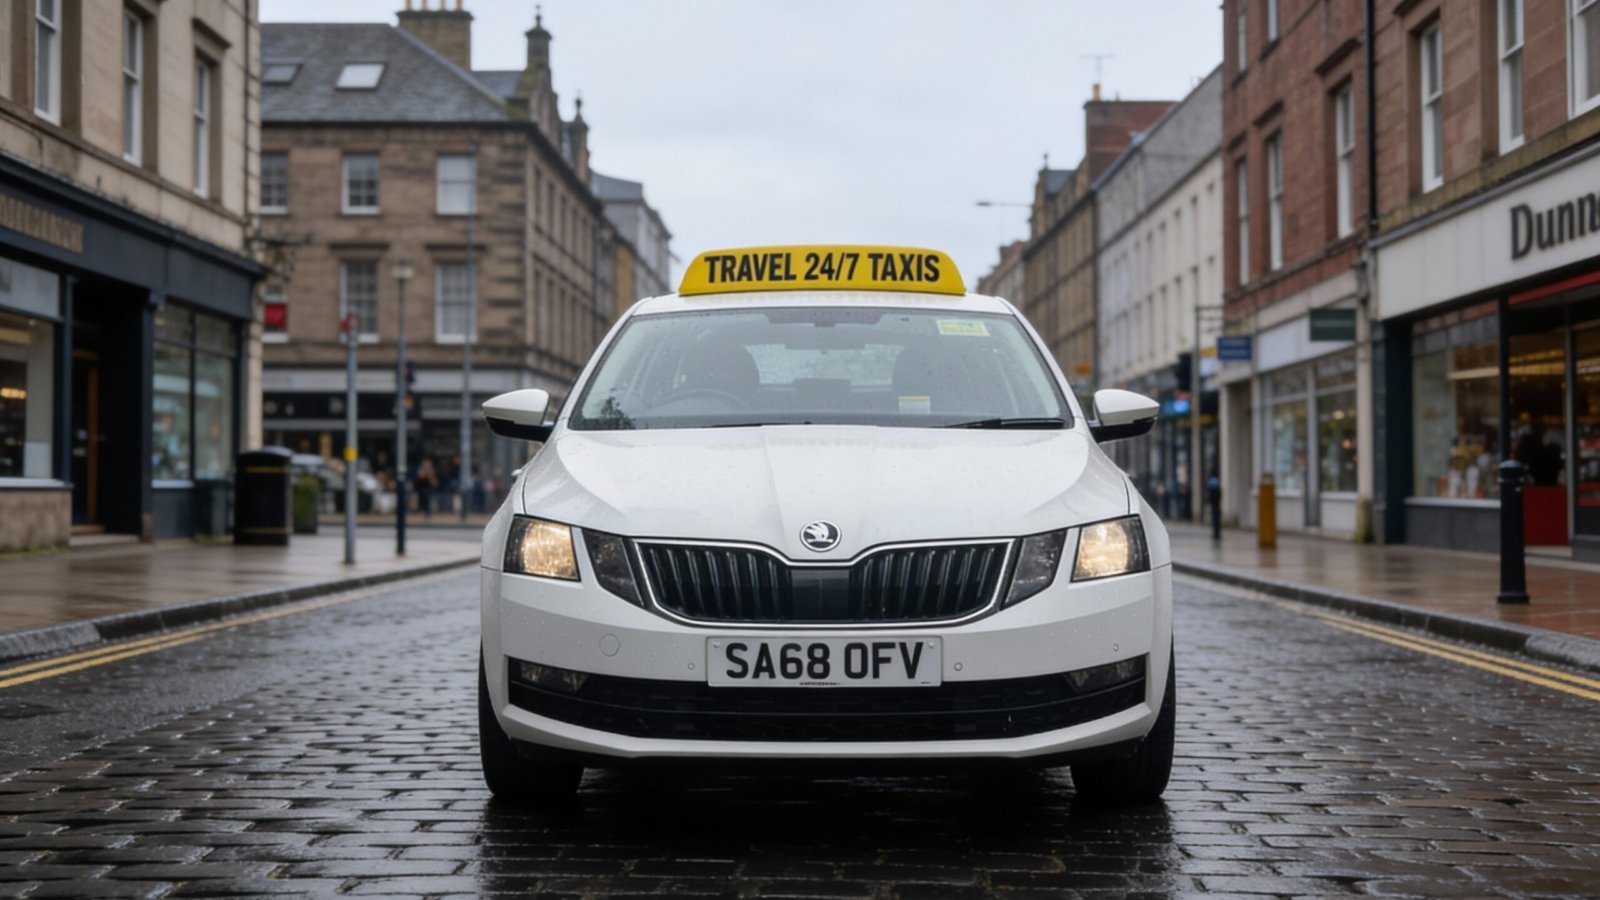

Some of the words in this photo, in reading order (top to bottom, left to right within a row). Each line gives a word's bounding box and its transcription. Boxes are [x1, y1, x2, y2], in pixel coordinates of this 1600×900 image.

[1510, 192, 1600, 261] Dunn
[704, 252, 797, 283] TRAVEL
[804, 252, 860, 281] 24/7
[867, 252, 940, 282] TAXIS
[725, 642, 831, 680] SA68
[844, 641, 924, 680] OFV
